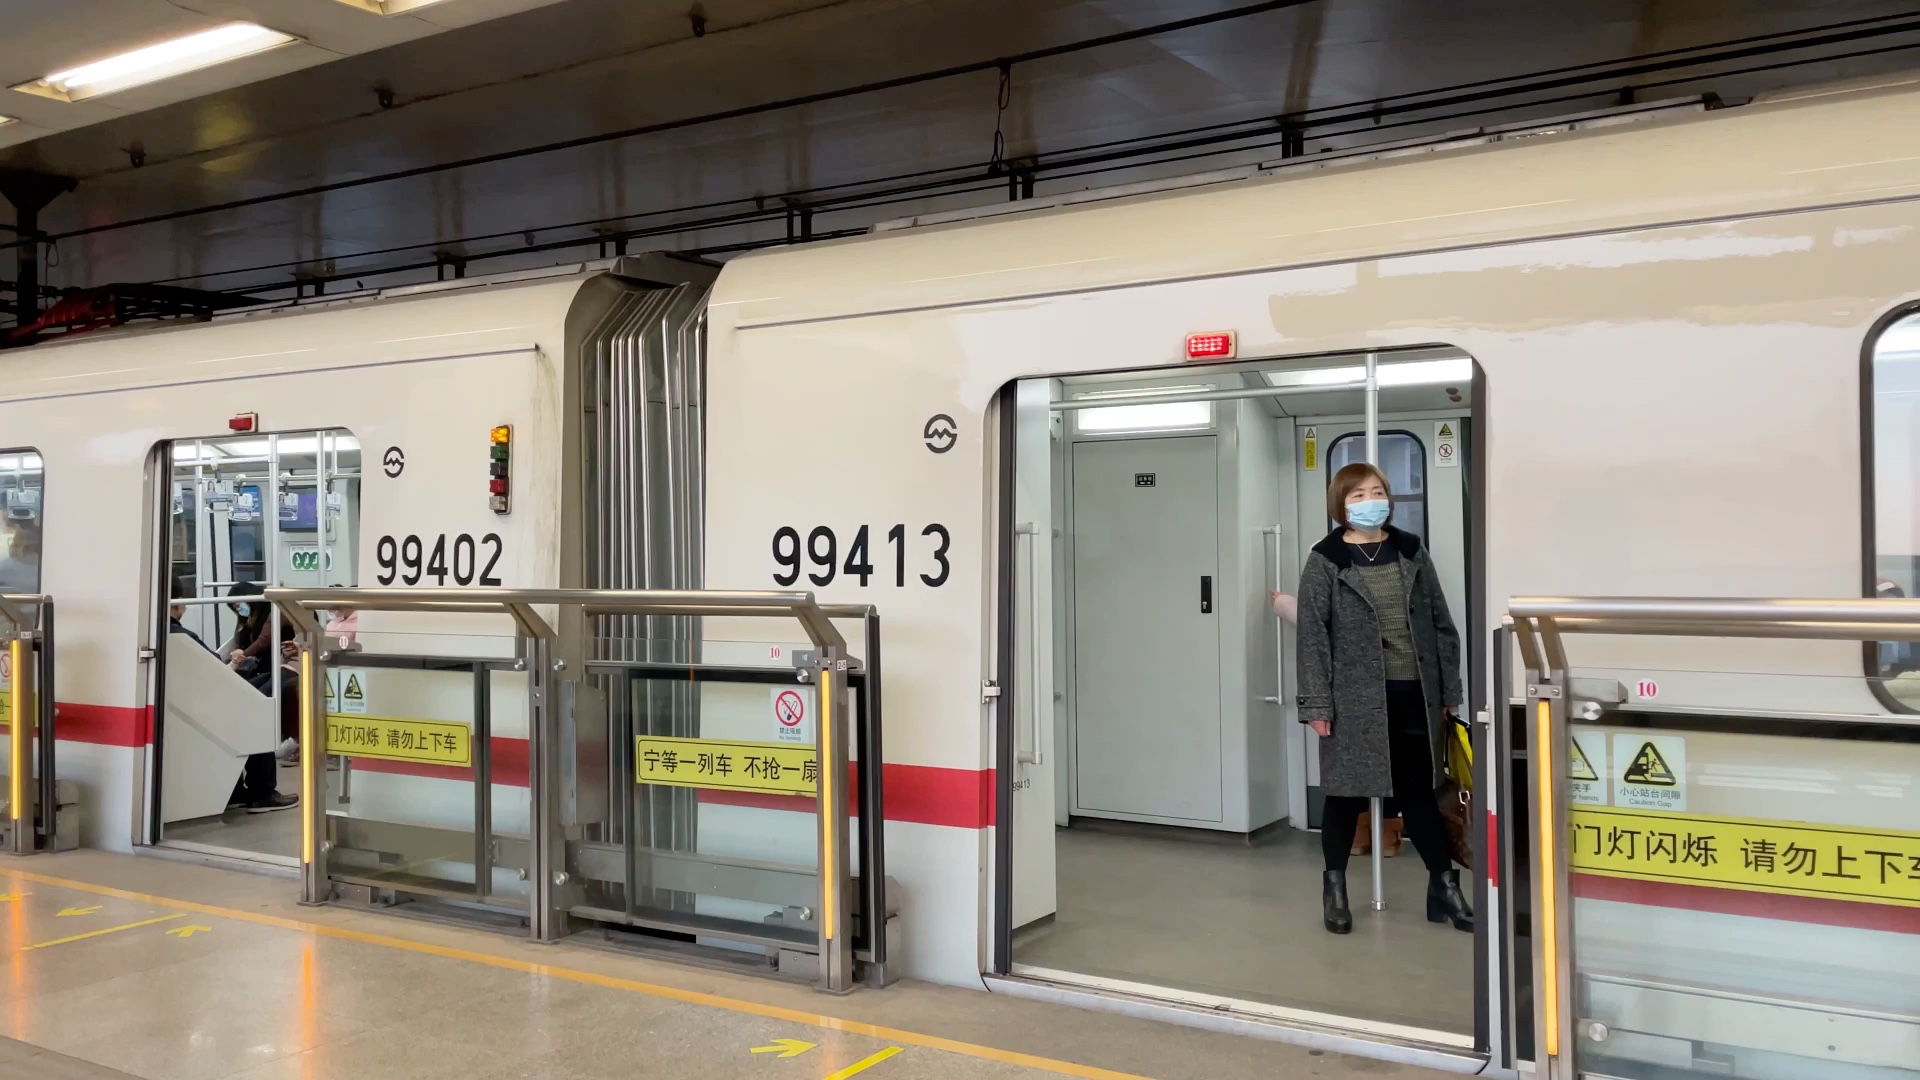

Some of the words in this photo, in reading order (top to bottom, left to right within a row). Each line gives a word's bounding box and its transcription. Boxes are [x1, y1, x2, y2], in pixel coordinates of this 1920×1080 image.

[377, 533, 502, 586] 99402
[772, 523, 950, 587] 99413
[770, 647, 780, 658] 10
[1638, 682, 1657, 697] 10
[327, 724, 379, 747] 门灯闪烁
[387, 728, 457, 754] 请勿上下车
[644, 749, 732, 777] 宁等一列车
[744, 756, 817, 783] 不抢一扇
[1620, 787, 1680, 799] 小心站台间隙
[1629, 798, 1655, 806] Caution
[1573, 824, 1718, 867] 门灯闪烁
